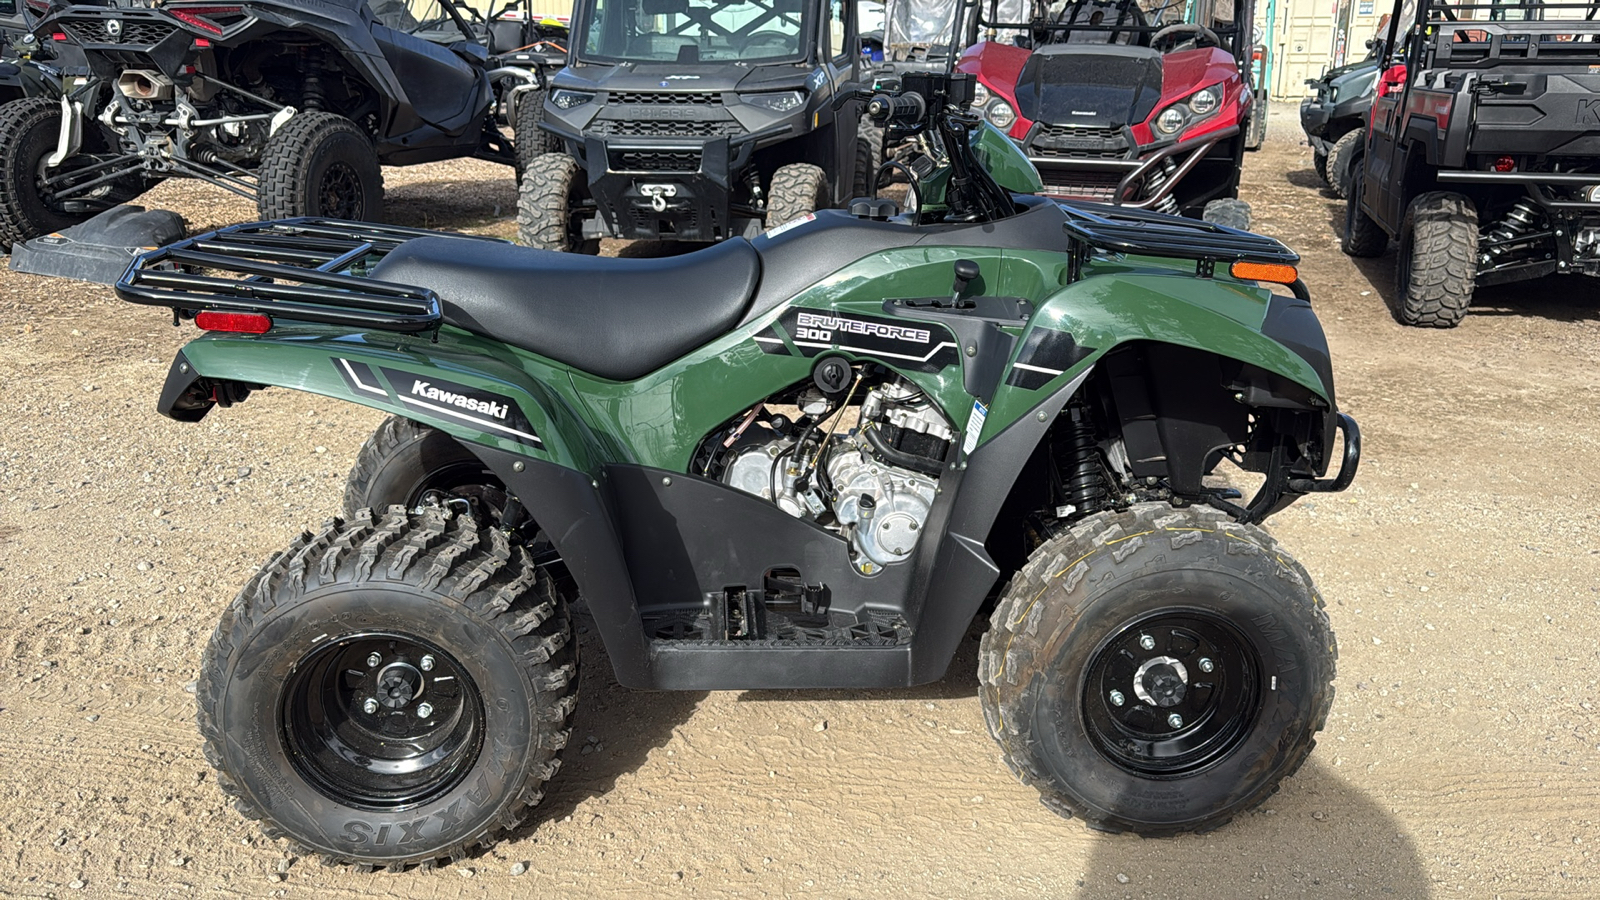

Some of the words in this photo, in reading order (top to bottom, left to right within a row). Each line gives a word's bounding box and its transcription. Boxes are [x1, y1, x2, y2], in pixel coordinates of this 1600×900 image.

[813, 71, 825, 90] XP
[629, 107, 696, 119] POLARIS
[796, 327, 831, 342] 300
[411, 379, 508, 419] Kawasaki
[341, 737, 513, 846] MAXXIS
